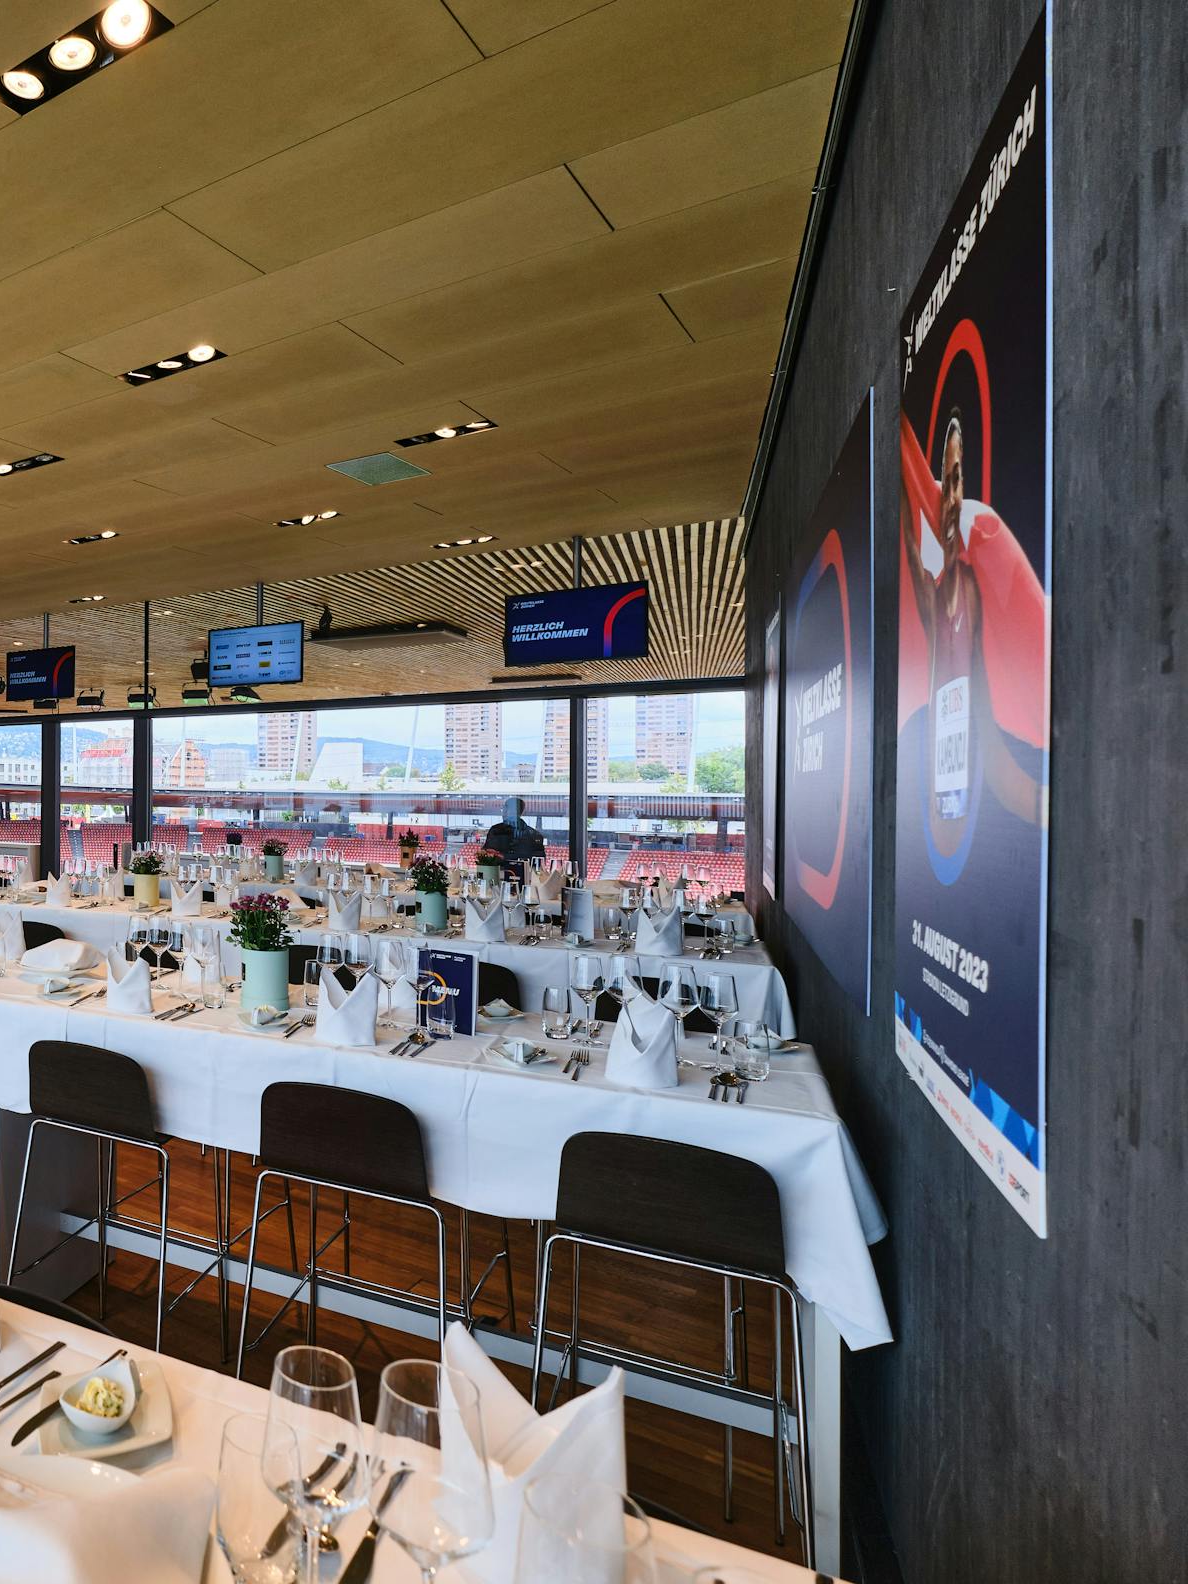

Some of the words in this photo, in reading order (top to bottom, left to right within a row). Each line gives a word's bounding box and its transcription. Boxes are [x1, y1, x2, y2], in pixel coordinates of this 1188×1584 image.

[914, 203, 979, 355] WELTKLASSE
[977, 84, 1038, 234] ZÜRICH
[511, 621, 565, 634] HERZLICH
[511, 628, 589, 642] WILLKOMMEN
[802, 663, 843, 727] WELTKLASSE
[912, 919, 924, 950] 31.
[923, 926, 960, 973] AUGUST
[958, 947, 989, 994] 2023
[431, 985, 460, 996] MENU
